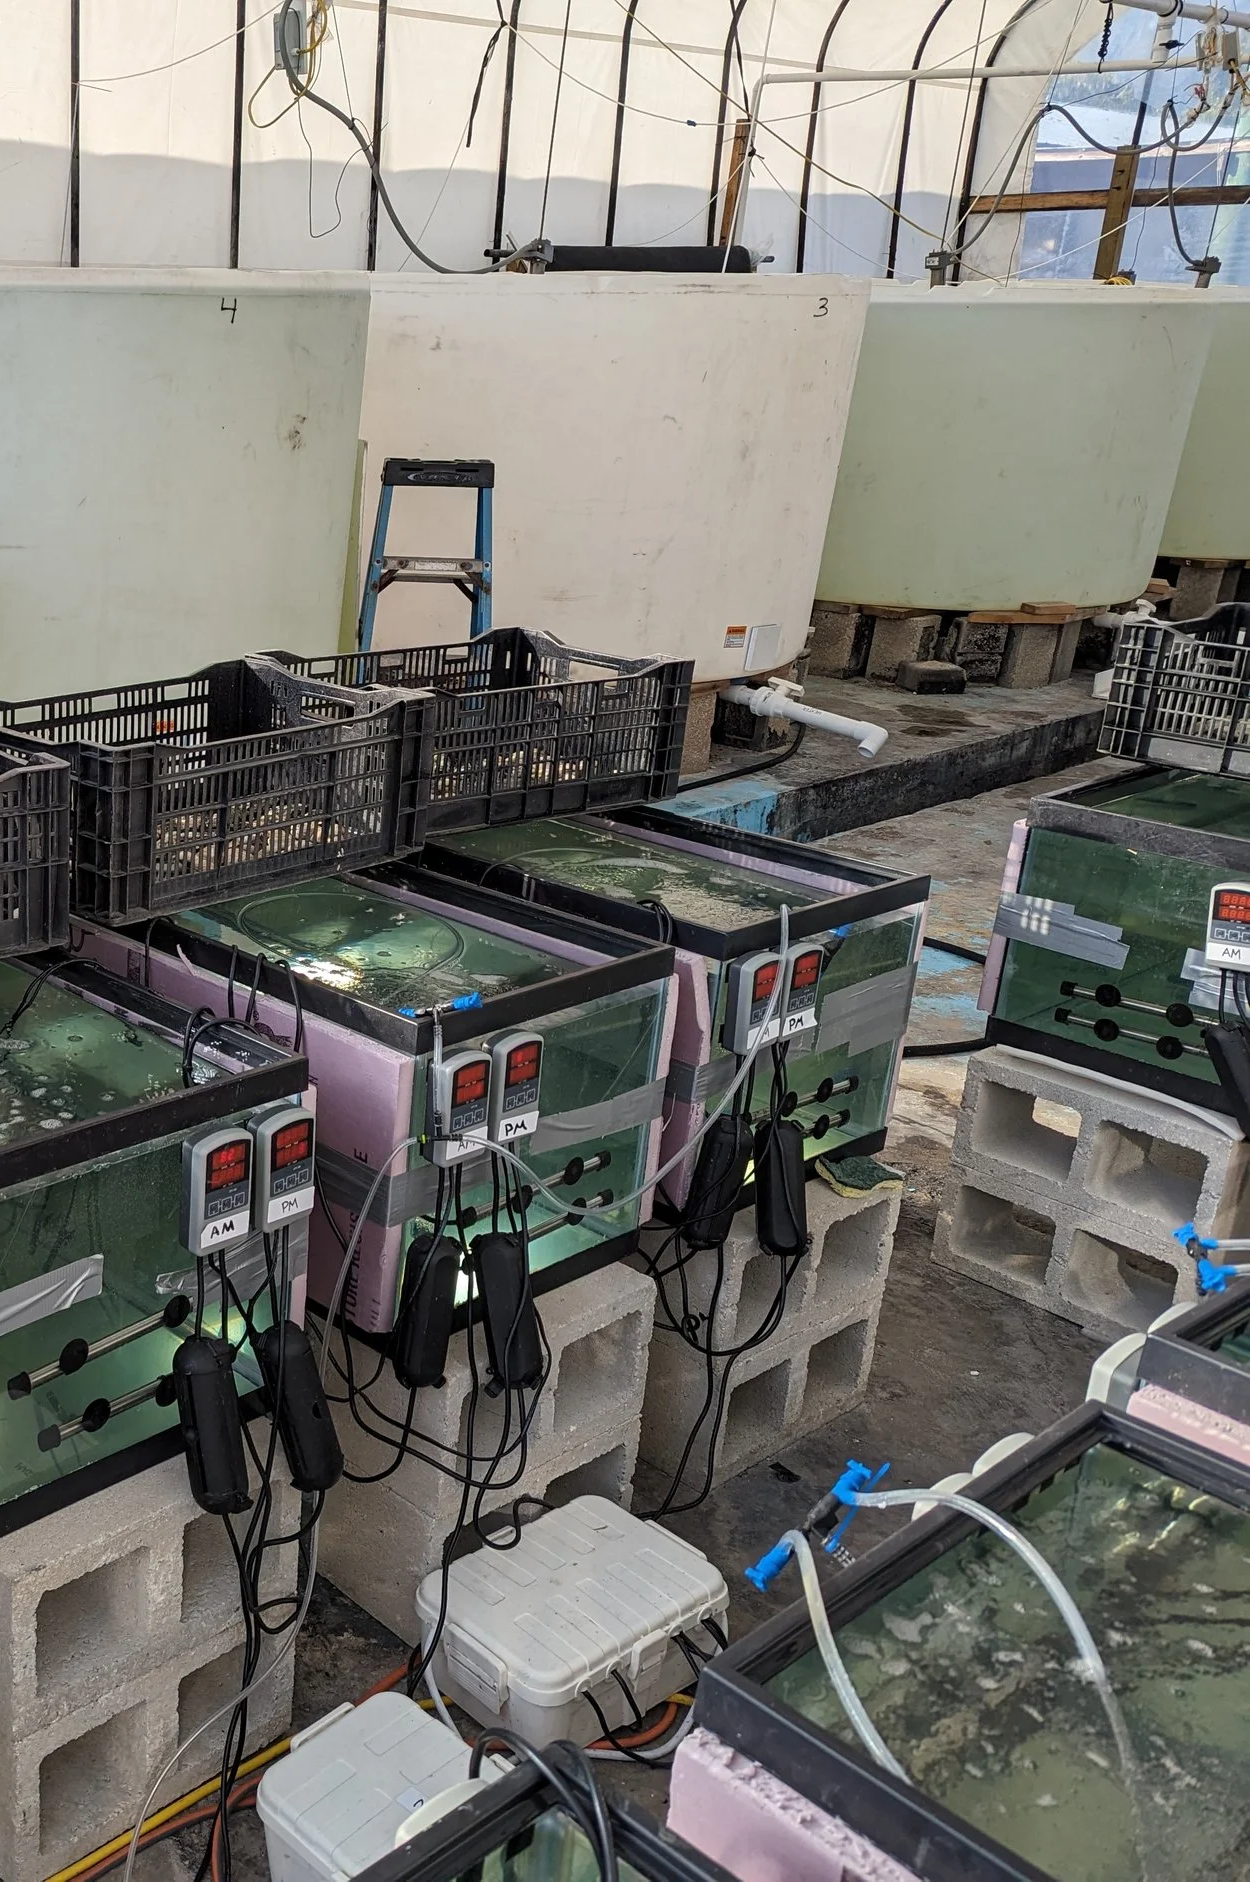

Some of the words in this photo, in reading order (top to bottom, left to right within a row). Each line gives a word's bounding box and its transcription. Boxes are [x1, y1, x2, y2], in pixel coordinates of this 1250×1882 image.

[220, 297, 237, 324] 4
[813, 297, 829, 317] 3
[1221, 947, 1241, 960] AM
[789, 1015, 804, 1031] PM
[504, 1119, 528, 1137] PM
[281, 1197, 299, 1214] PM
[210, 1219, 235, 1240] AM
